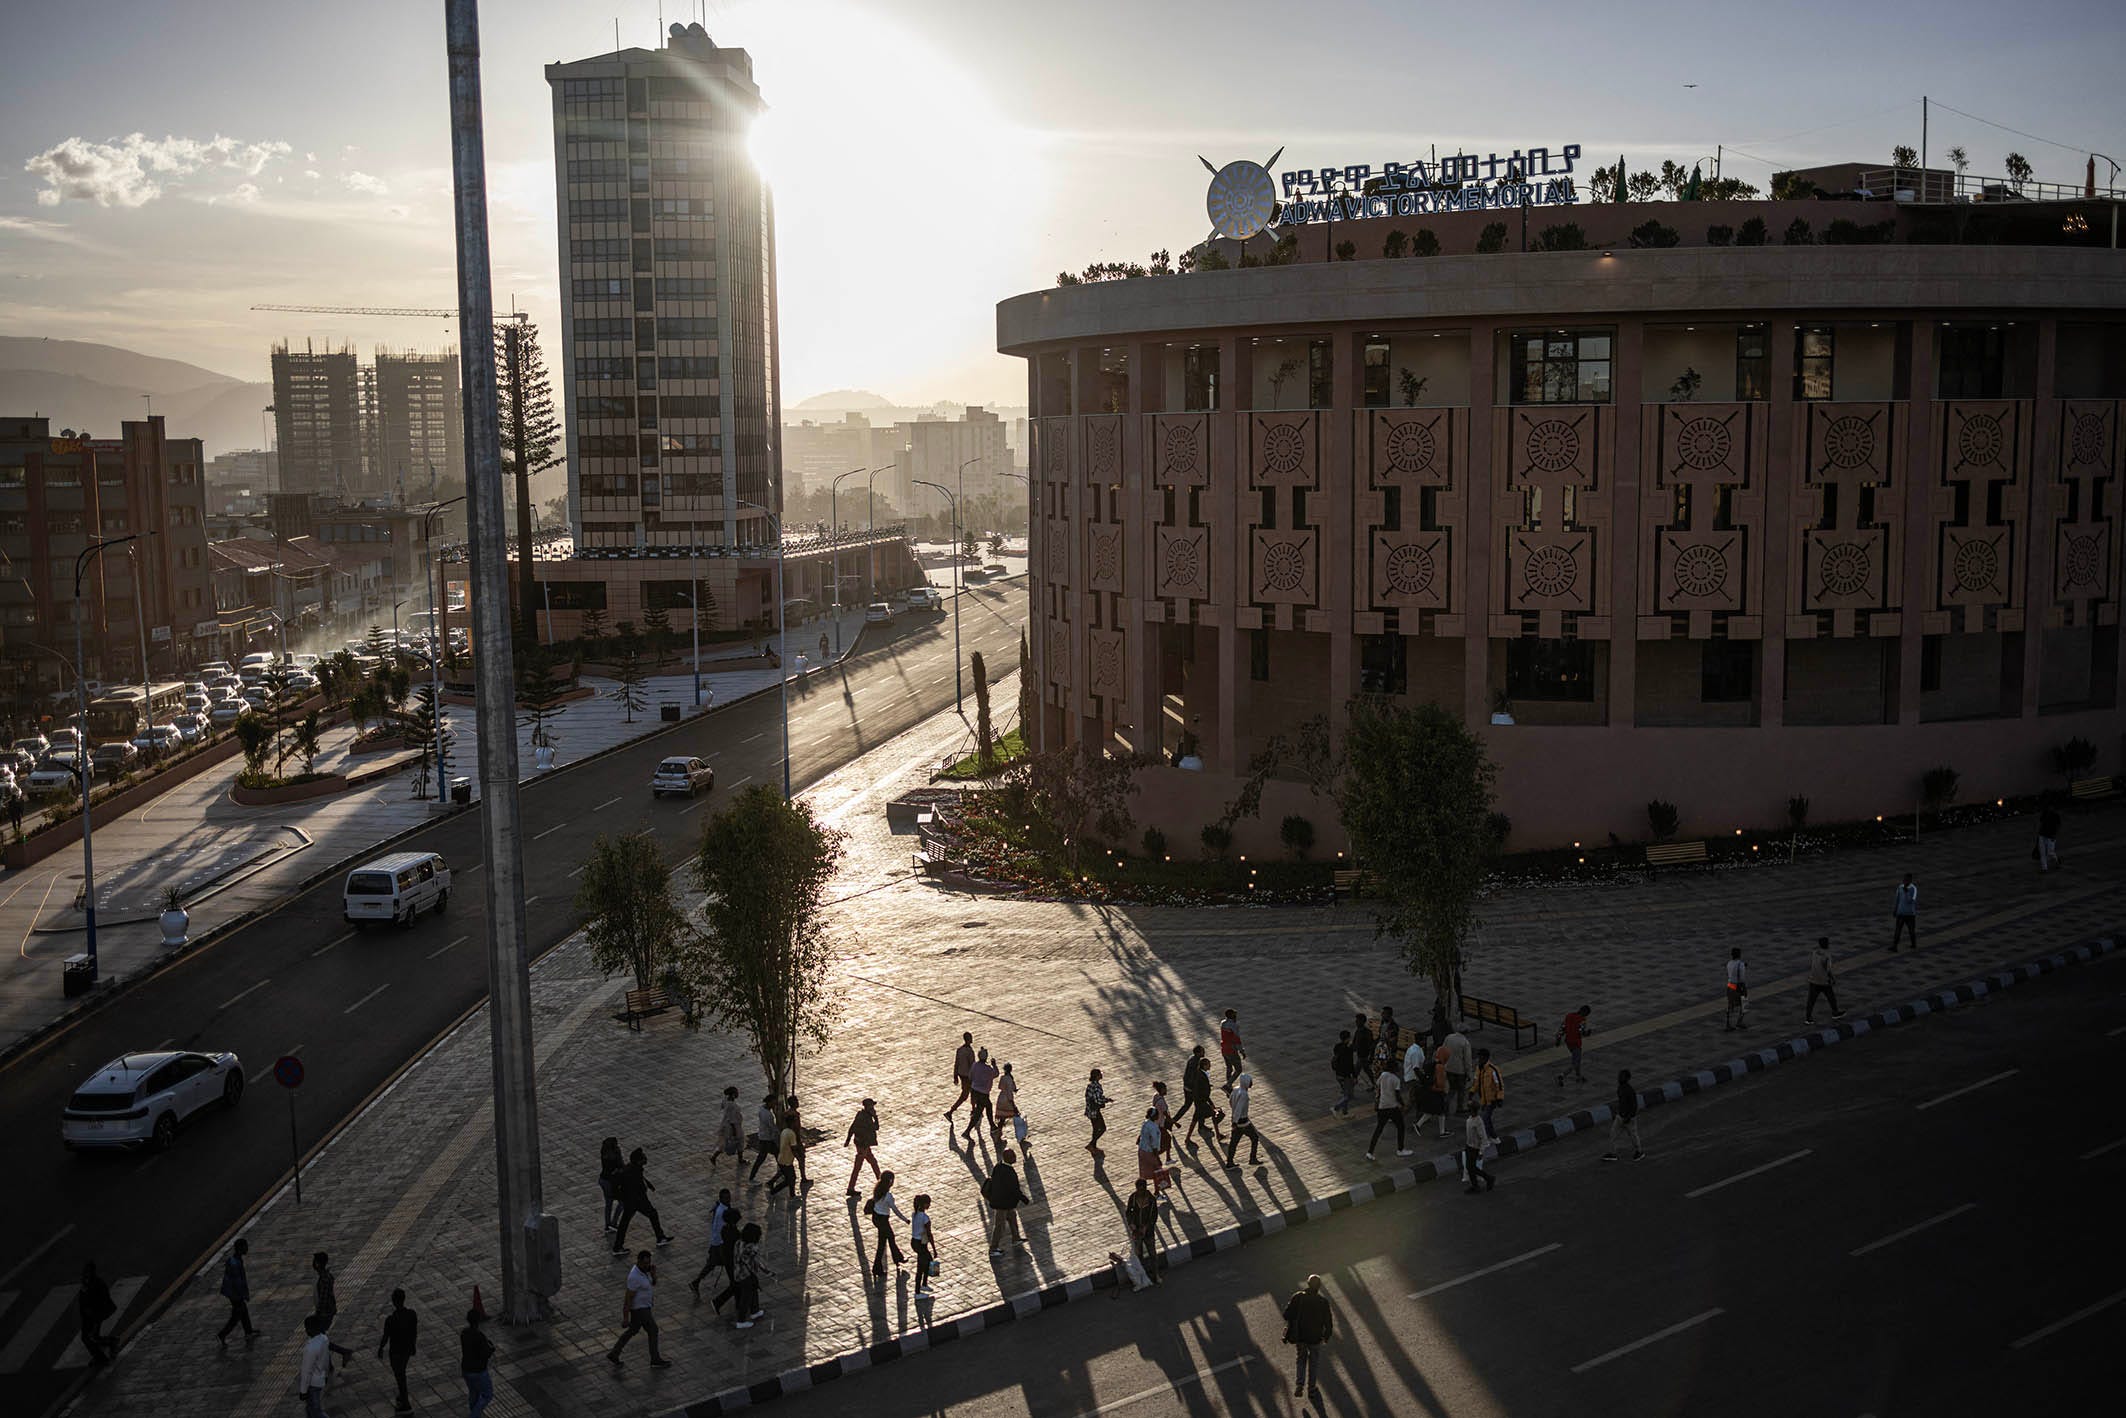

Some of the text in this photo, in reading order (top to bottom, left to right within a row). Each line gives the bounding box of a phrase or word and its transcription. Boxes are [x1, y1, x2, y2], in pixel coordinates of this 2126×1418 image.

[1281, 144, 1582, 198] የዓድዋ ድል መታሰቢያ
[1279, 179, 1580, 226] ADWA VICTORY MEMORIAL
